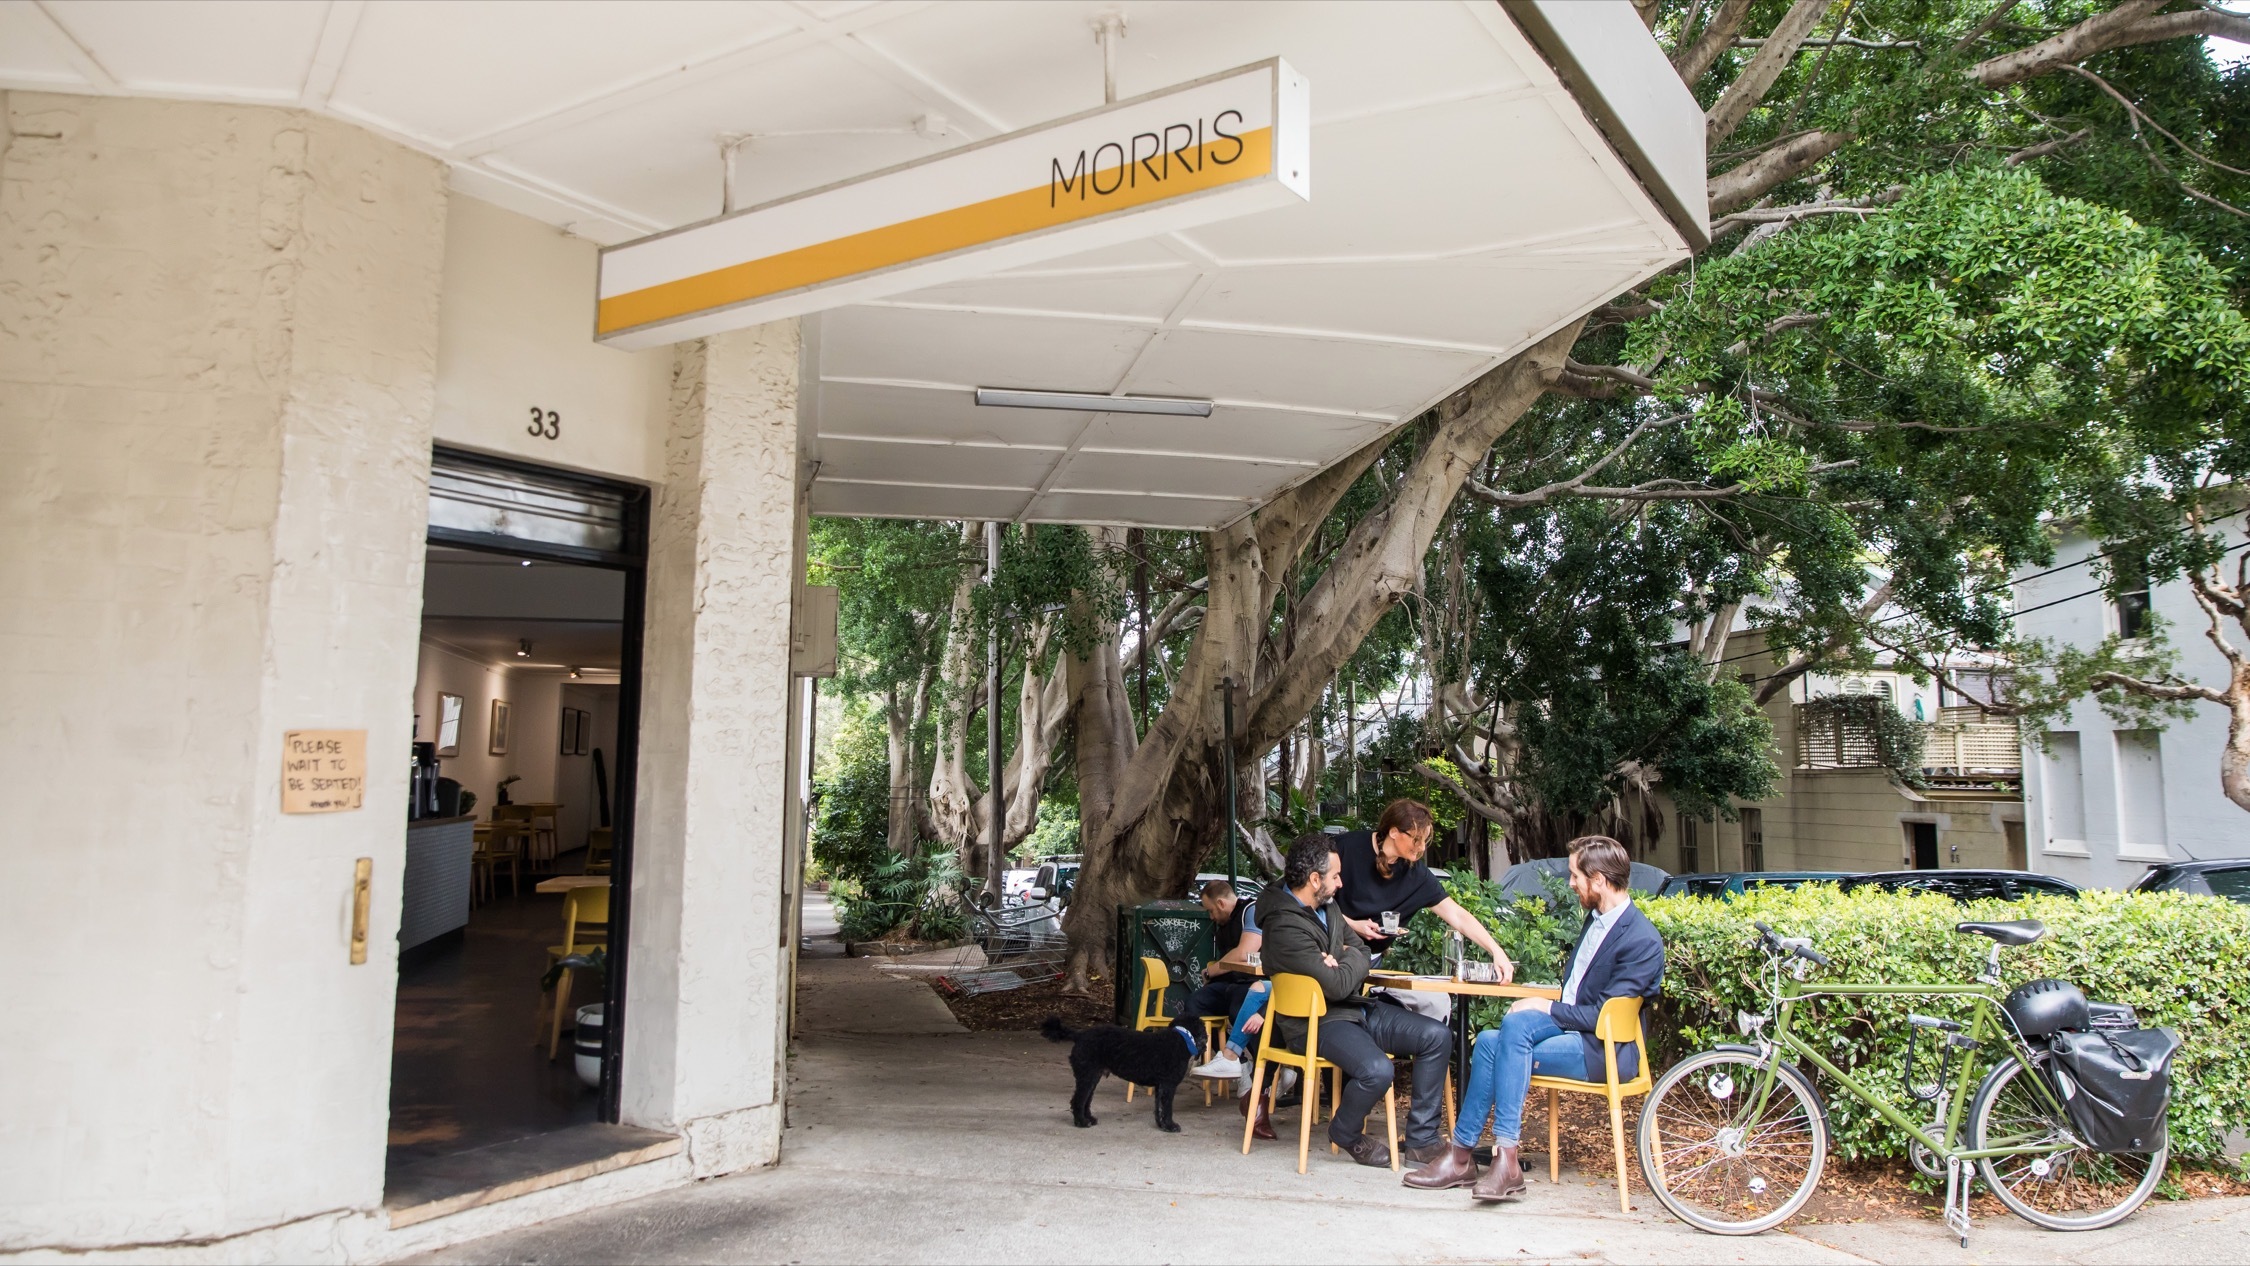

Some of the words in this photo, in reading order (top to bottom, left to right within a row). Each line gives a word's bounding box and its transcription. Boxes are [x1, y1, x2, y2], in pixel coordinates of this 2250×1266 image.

[1051, 109, 1244, 208] MORRIS
[527, 406, 560, 440] 33
[293, 740, 343, 754] PLEASE
[287, 759, 321, 772] WAIT
[330, 759, 347, 771] TO
[288, 778, 305, 791] BE
